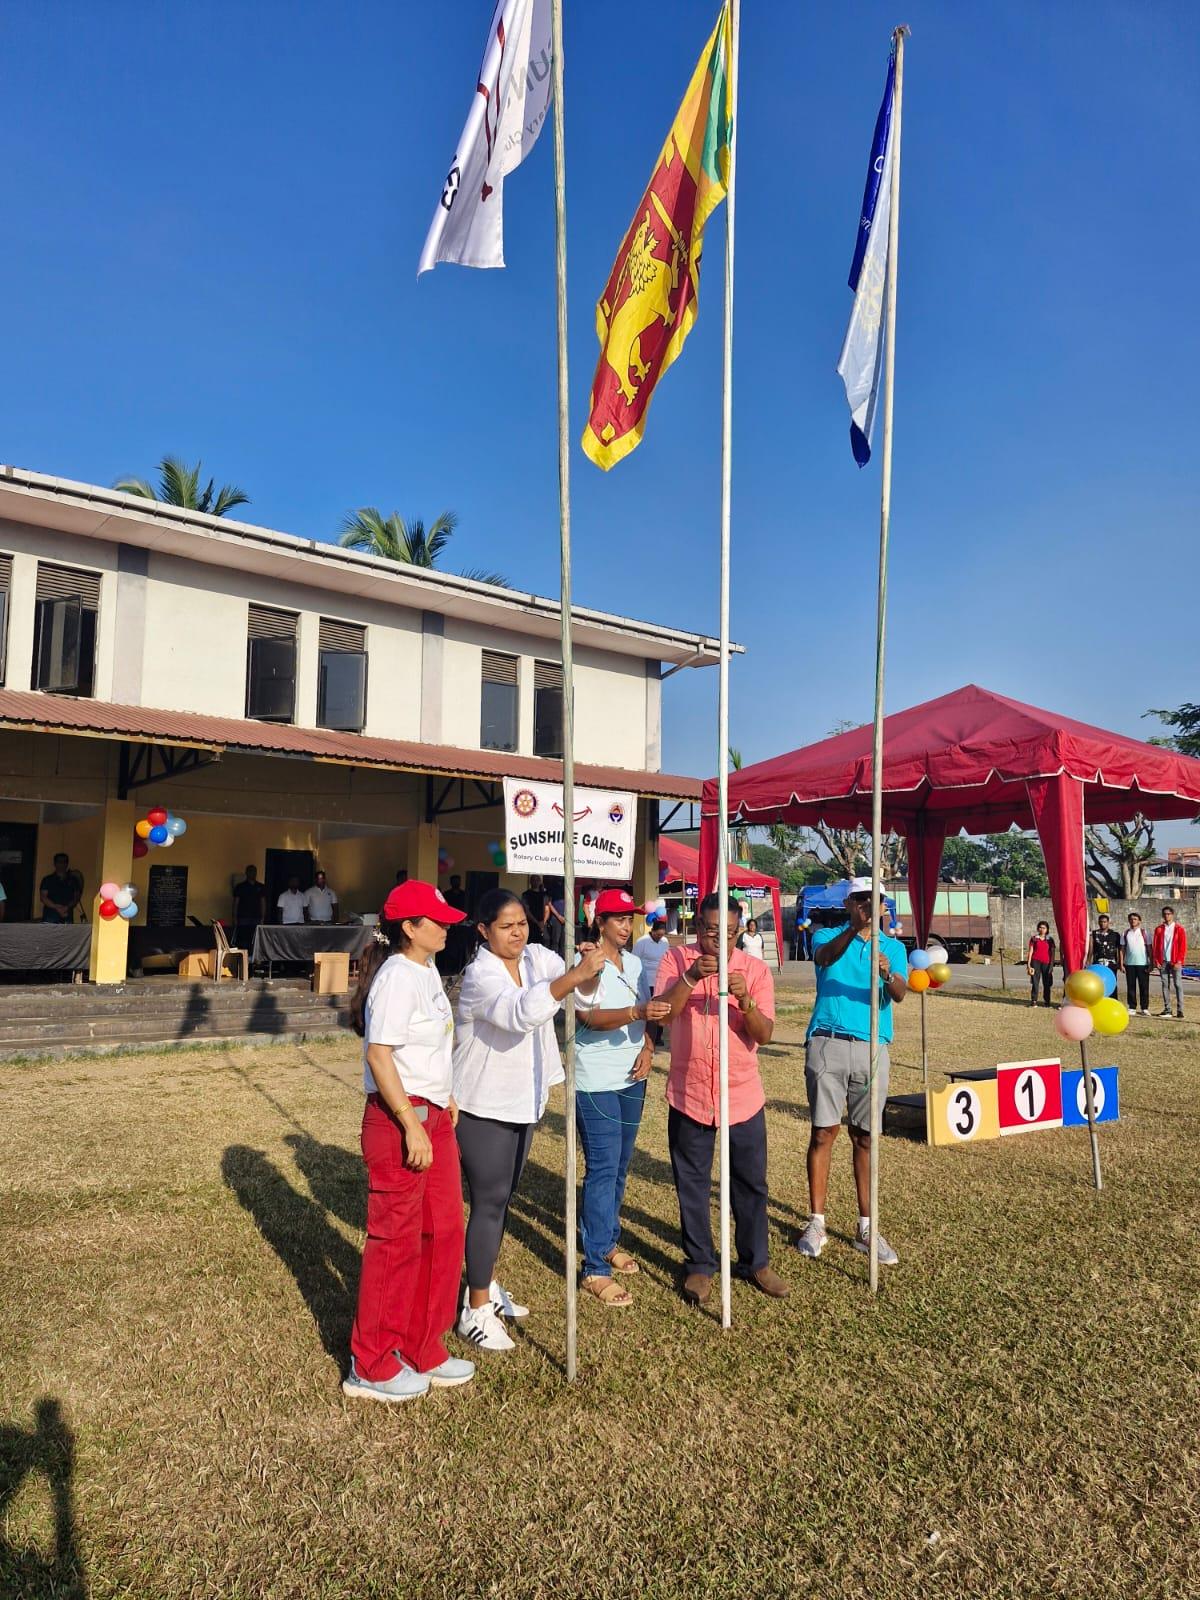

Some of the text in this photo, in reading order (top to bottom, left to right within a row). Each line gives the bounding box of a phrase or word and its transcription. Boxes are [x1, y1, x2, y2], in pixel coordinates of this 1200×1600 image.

[510, 831, 624, 859] SUNSHIE GAMES
[513, 853, 533, 862] Rotary
[587, 858, 621, 866] Metropolitan
[955, 1090, 974, 1135] 3
[1021, 1075, 1035, 1118] 1
